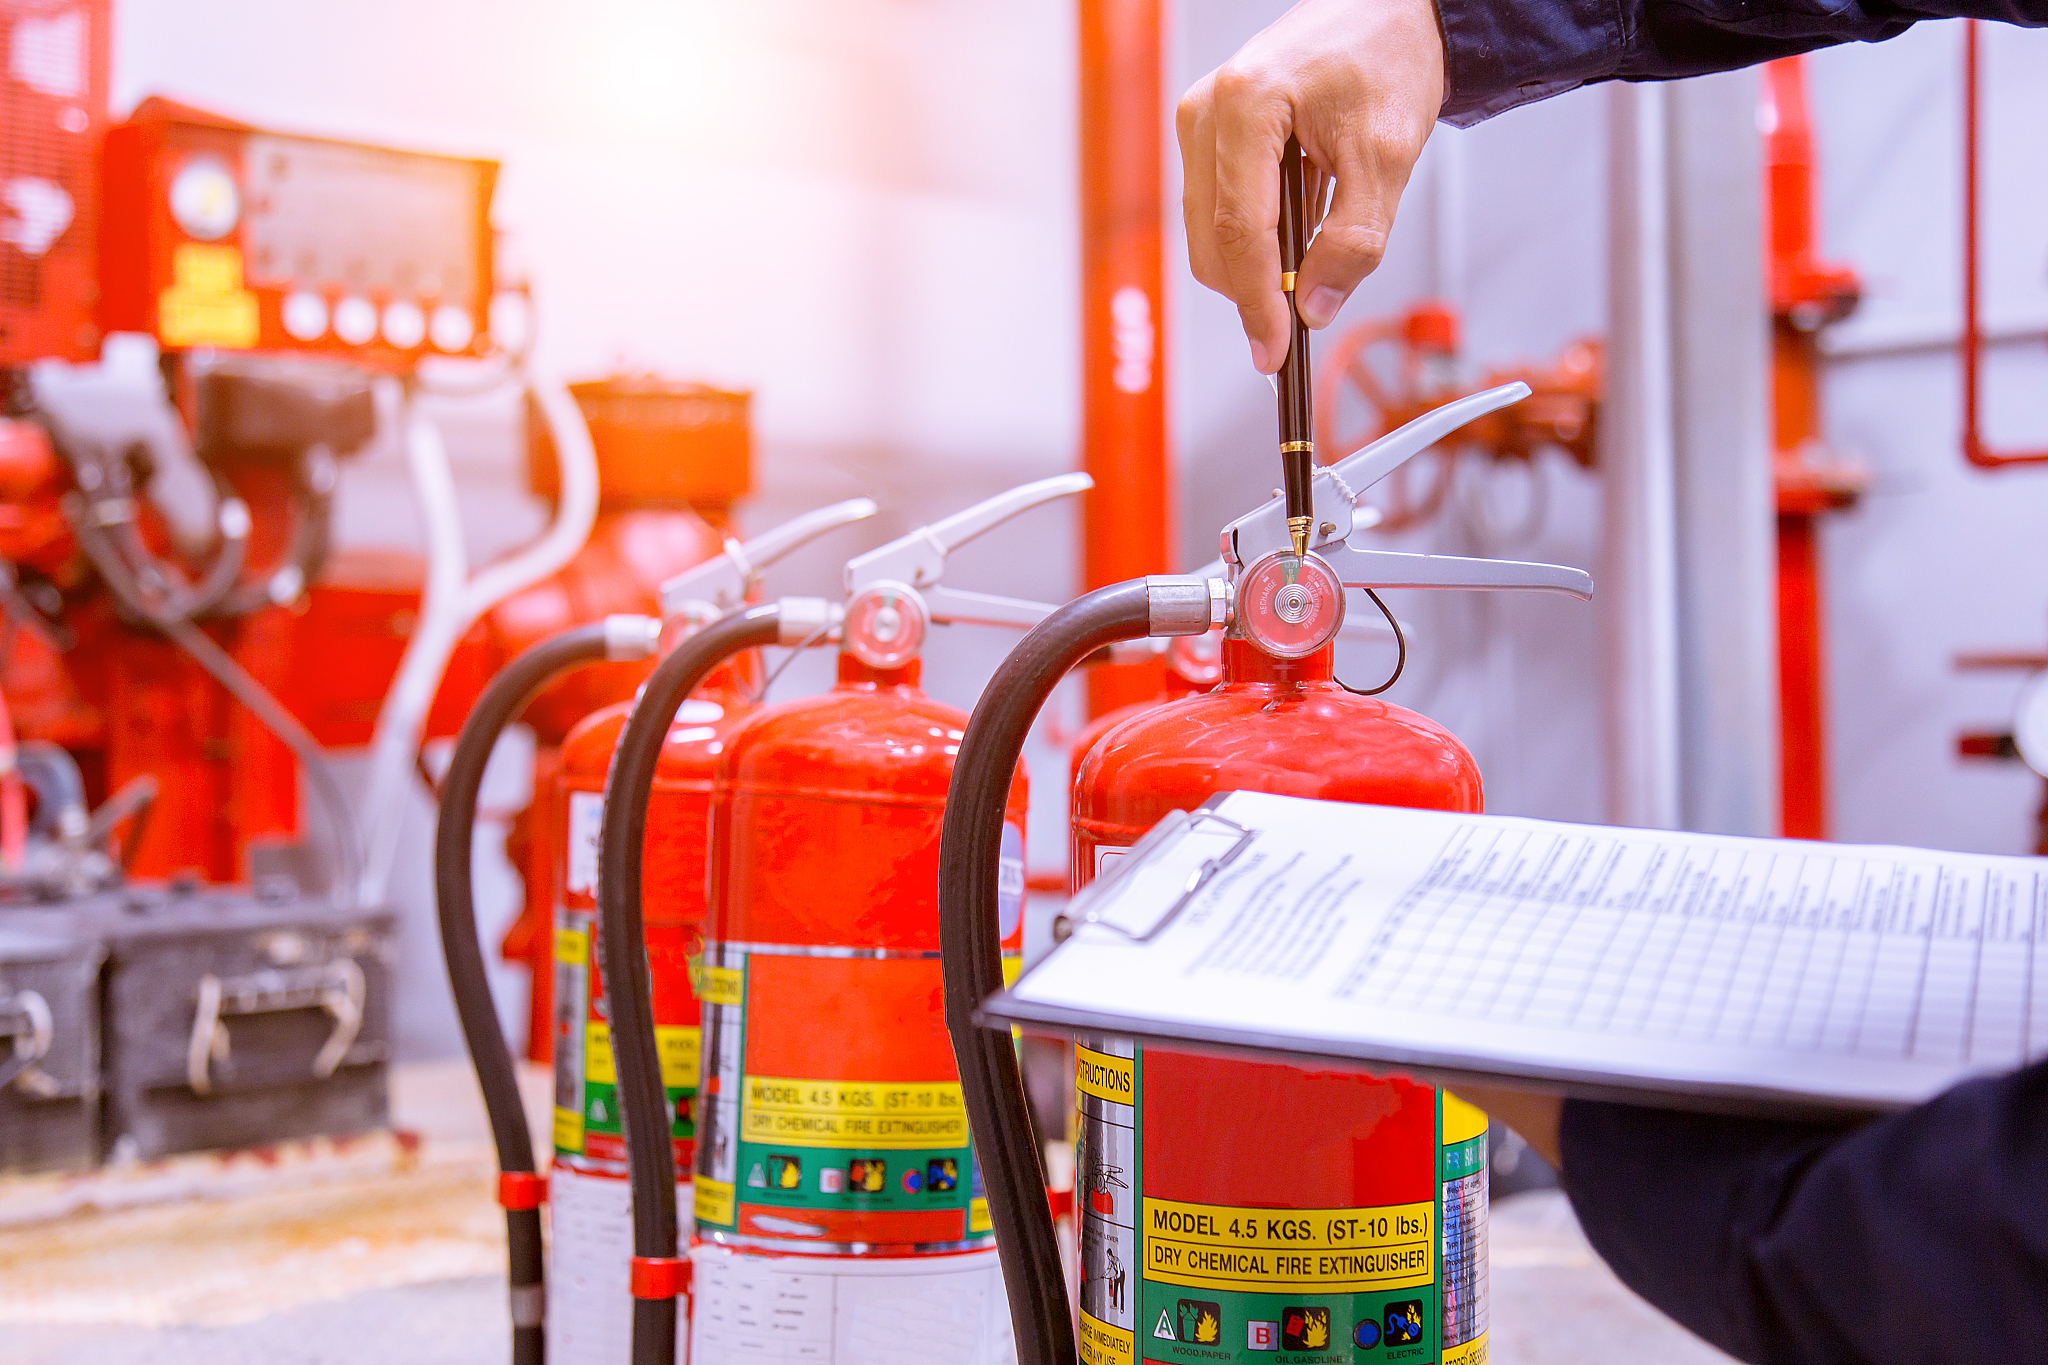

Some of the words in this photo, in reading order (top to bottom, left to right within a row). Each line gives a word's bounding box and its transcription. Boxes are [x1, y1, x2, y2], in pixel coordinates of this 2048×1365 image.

[1260, 579, 1277, 615] RECHARGE
[1302, 580, 1321, 630] OVERCHARGED
[752, 1086, 801, 1104] MODEL
[777, 1116, 839, 1133] CHEMICAL
[844, 1119, 873, 1134] FIRE
[878, 1119, 961, 1135] EXTINGUISHER
[1153, 1208, 1220, 1237] MODEL
[1228, 1218, 1258, 1239] 4.5
[1267, 1219, 1316, 1240] KGS.
[1327, 1217, 1388, 1245] (ST-10
[1396, 1212, 1428, 1238] lbs.)
[1446, 1219, 1457, 1230] Test
[1155, 1245, 1182, 1266] DRY
[1188, 1250, 1269, 1274] CHEMICAL
[1276, 1256, 1312, 1275] FIRE
[1319, 1249, 1425, 1275] EXTINGUISHER
[1158, 1316, 1172, 1336] A
[1256, 1327, 1271, 1345] B
[1093, 1328, 1131, 1355] IMMEDIATELY
[1386, 1347, 1424, 1360] ELECTRIC
